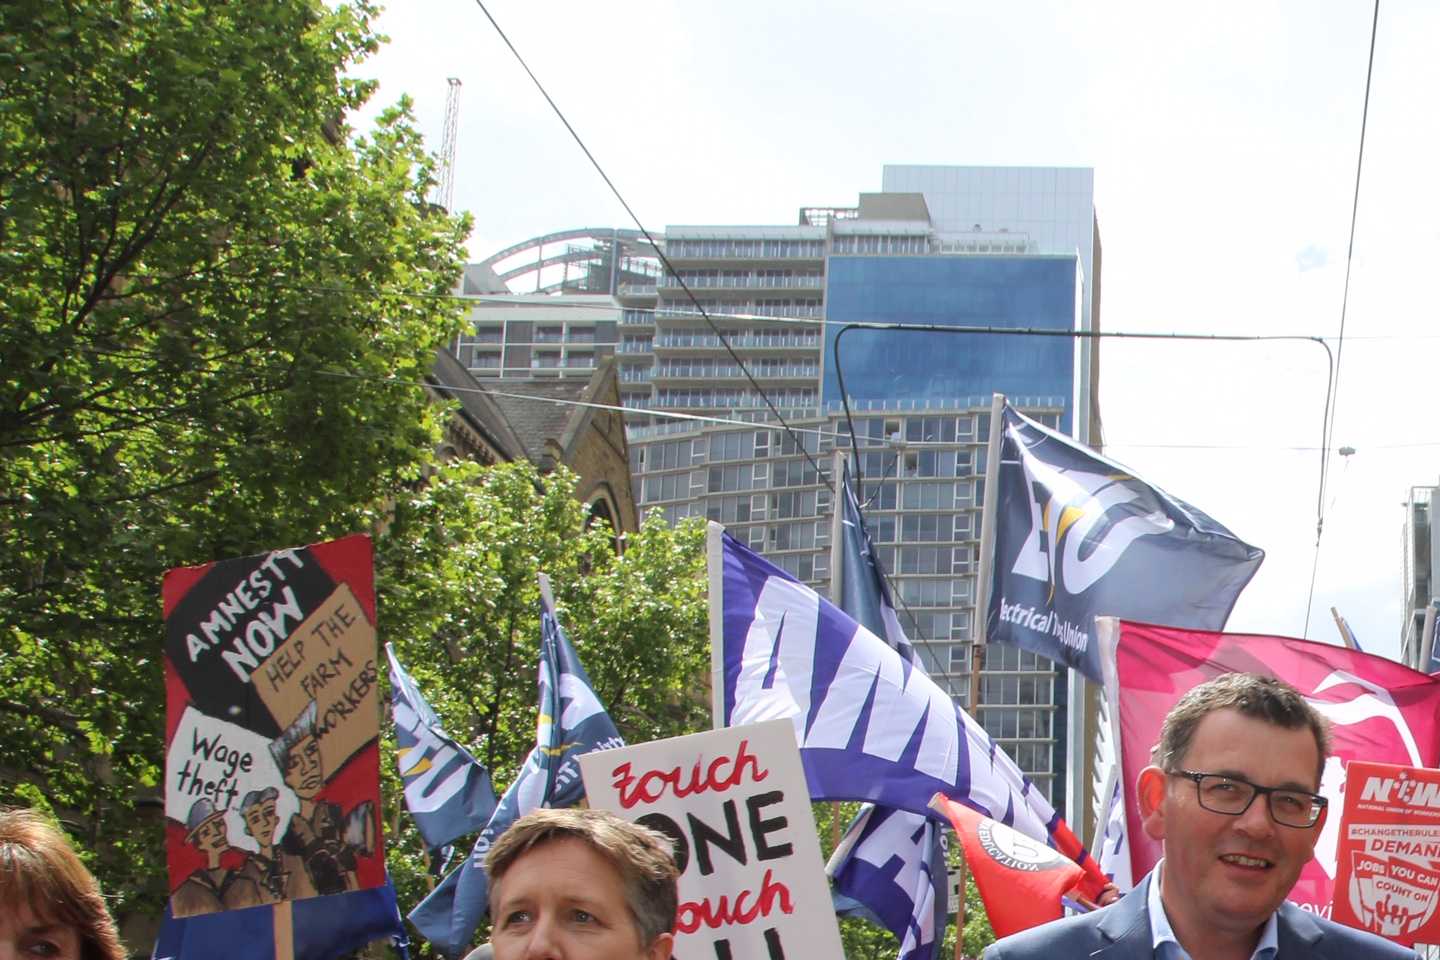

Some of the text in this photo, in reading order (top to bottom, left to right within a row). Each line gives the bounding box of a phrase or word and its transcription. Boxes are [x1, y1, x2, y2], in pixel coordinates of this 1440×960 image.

[222, 586, 304, 683] NOW
[1000, 597, 1053, 632] lectrical
[267, 604, 356, 692] HELP THE
[301, 649, 353, 698] FARM
[192, 728, 253, 778] Wage
[612, 740, 769, 809] touch
[177, 760, 239, 810] theft
[1376, 880, 1430, 903] COUNT ON
[1391, 865, 1416, 880] YOU
[1417, 873, 1438, 887] CAN
[673, 868, 794, 935] ouch
